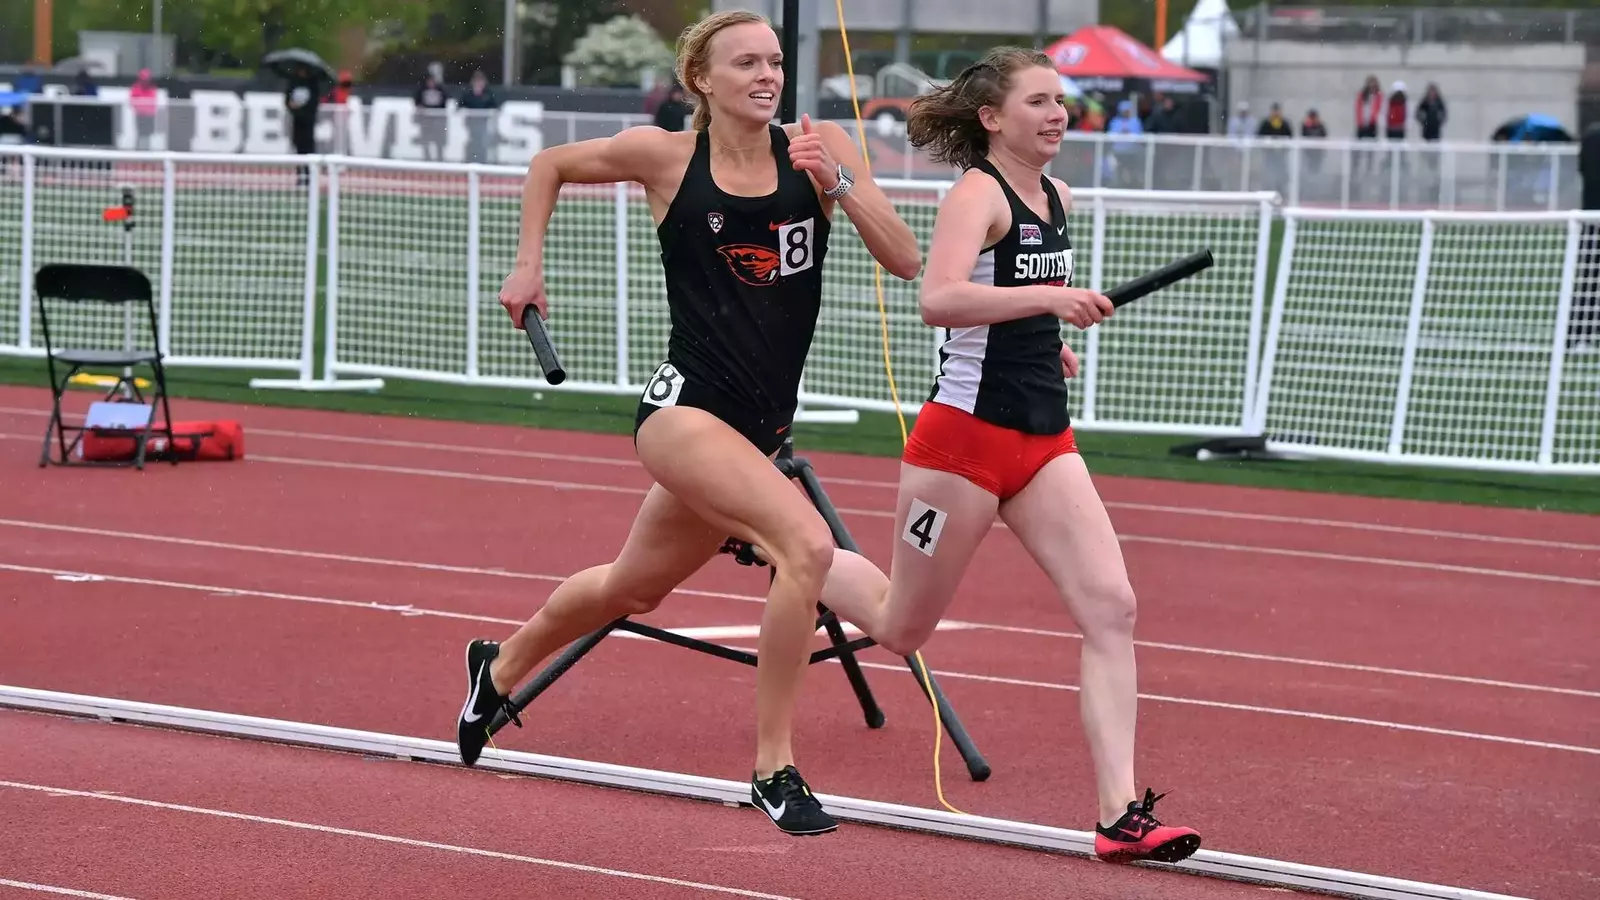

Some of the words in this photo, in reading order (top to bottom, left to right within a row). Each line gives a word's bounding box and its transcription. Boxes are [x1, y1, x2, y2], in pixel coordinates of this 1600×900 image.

[189, 90, 543, 164] BEVES
[786, 226, 808, 269] 8
[1014, 249, 1073, 282] SOUTH
[649, 364, 678, 401] 8
[909, 508, 937, 549] 4
